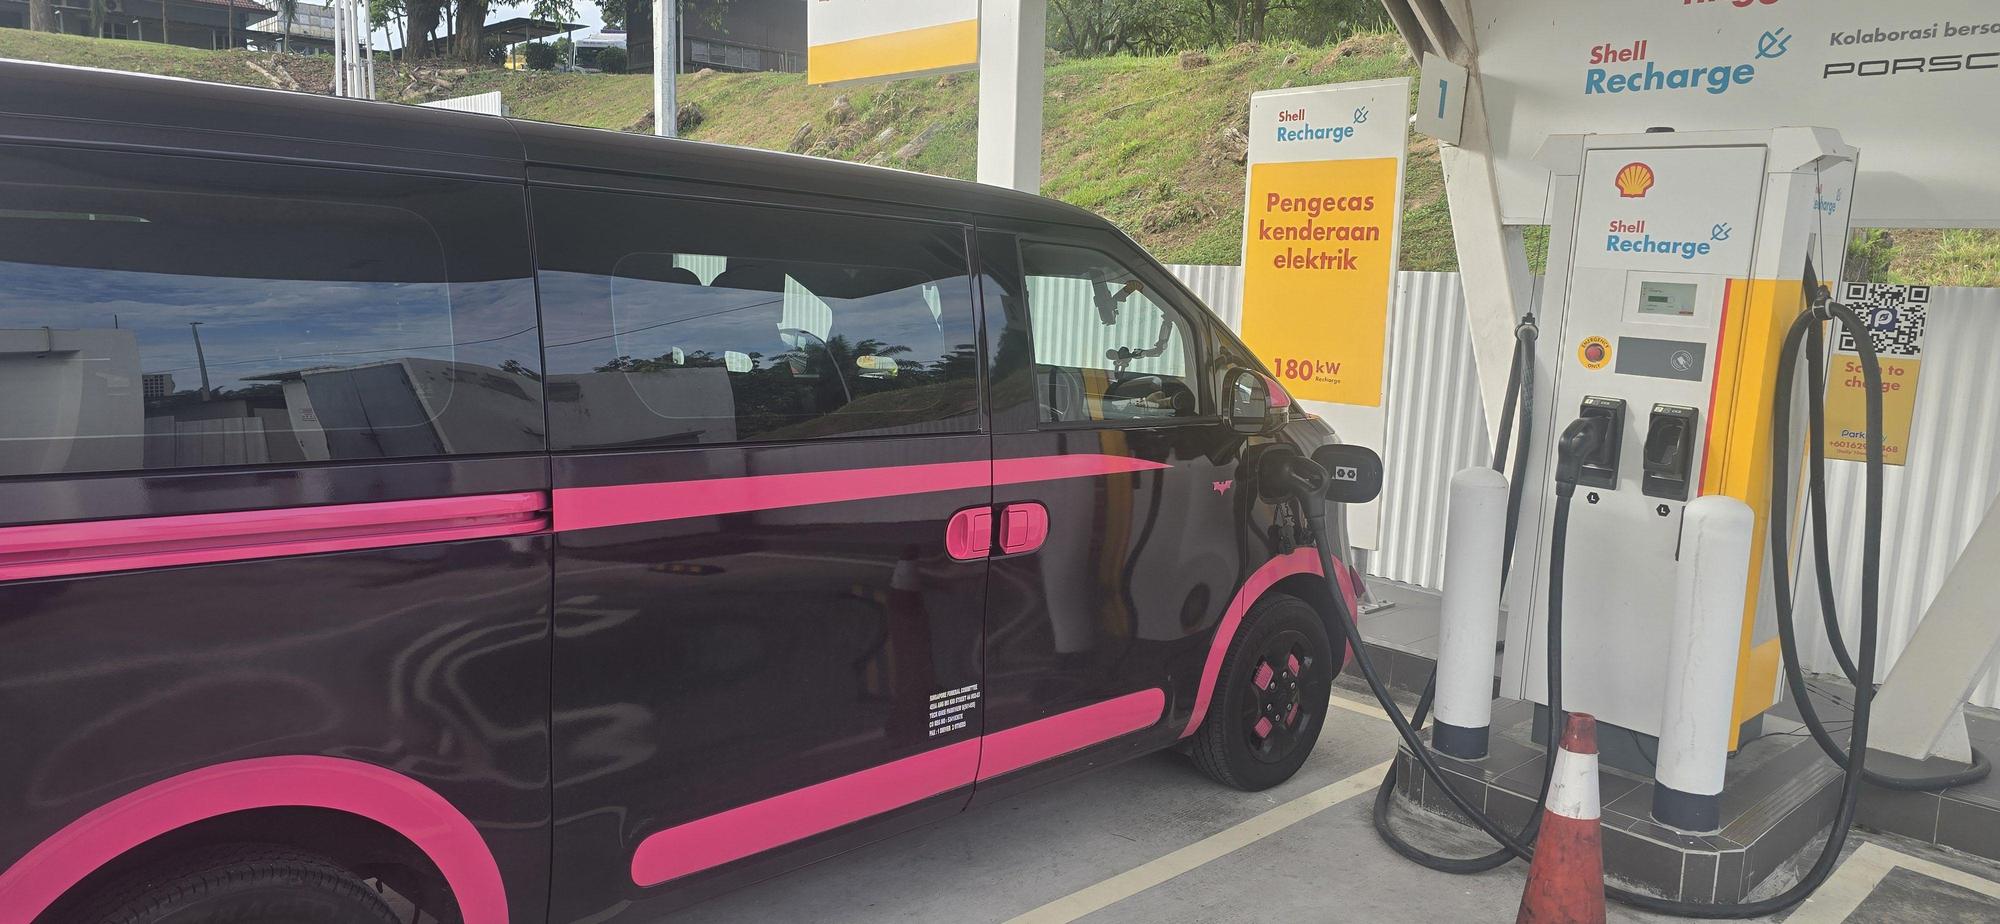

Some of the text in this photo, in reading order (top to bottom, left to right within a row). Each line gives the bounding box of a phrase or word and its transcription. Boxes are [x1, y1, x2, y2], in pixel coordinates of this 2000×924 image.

[1829, 23, 1938, 47] Kolaborasi
[1589, 39, 1648, 65] Shell
[1584, 61, 1756, 96] Recharge
[1438, 79, 1448, 119] 1
[1278, 109, 1306, 123] Shell
[1276, 123, 1355, 144] Recharge
[1266, 192, 1375, 218] Pengecas
[1259, 218, 1380, 242] kenderaan
[1608, 220, 1646, 234] Shell
[1606, 234, 1711, 260] Recharge
[1273, 247, 1360, 271] elektrik
[1581, 336, 1610, 349] EMERGENCY
[1274, 358, 1341, 381] 180 kW
[1315, 375, 1341, 385] Recharge
[1844, 361, 1905, 377] Sc to
[1844, 376, 1901, 393] chge
